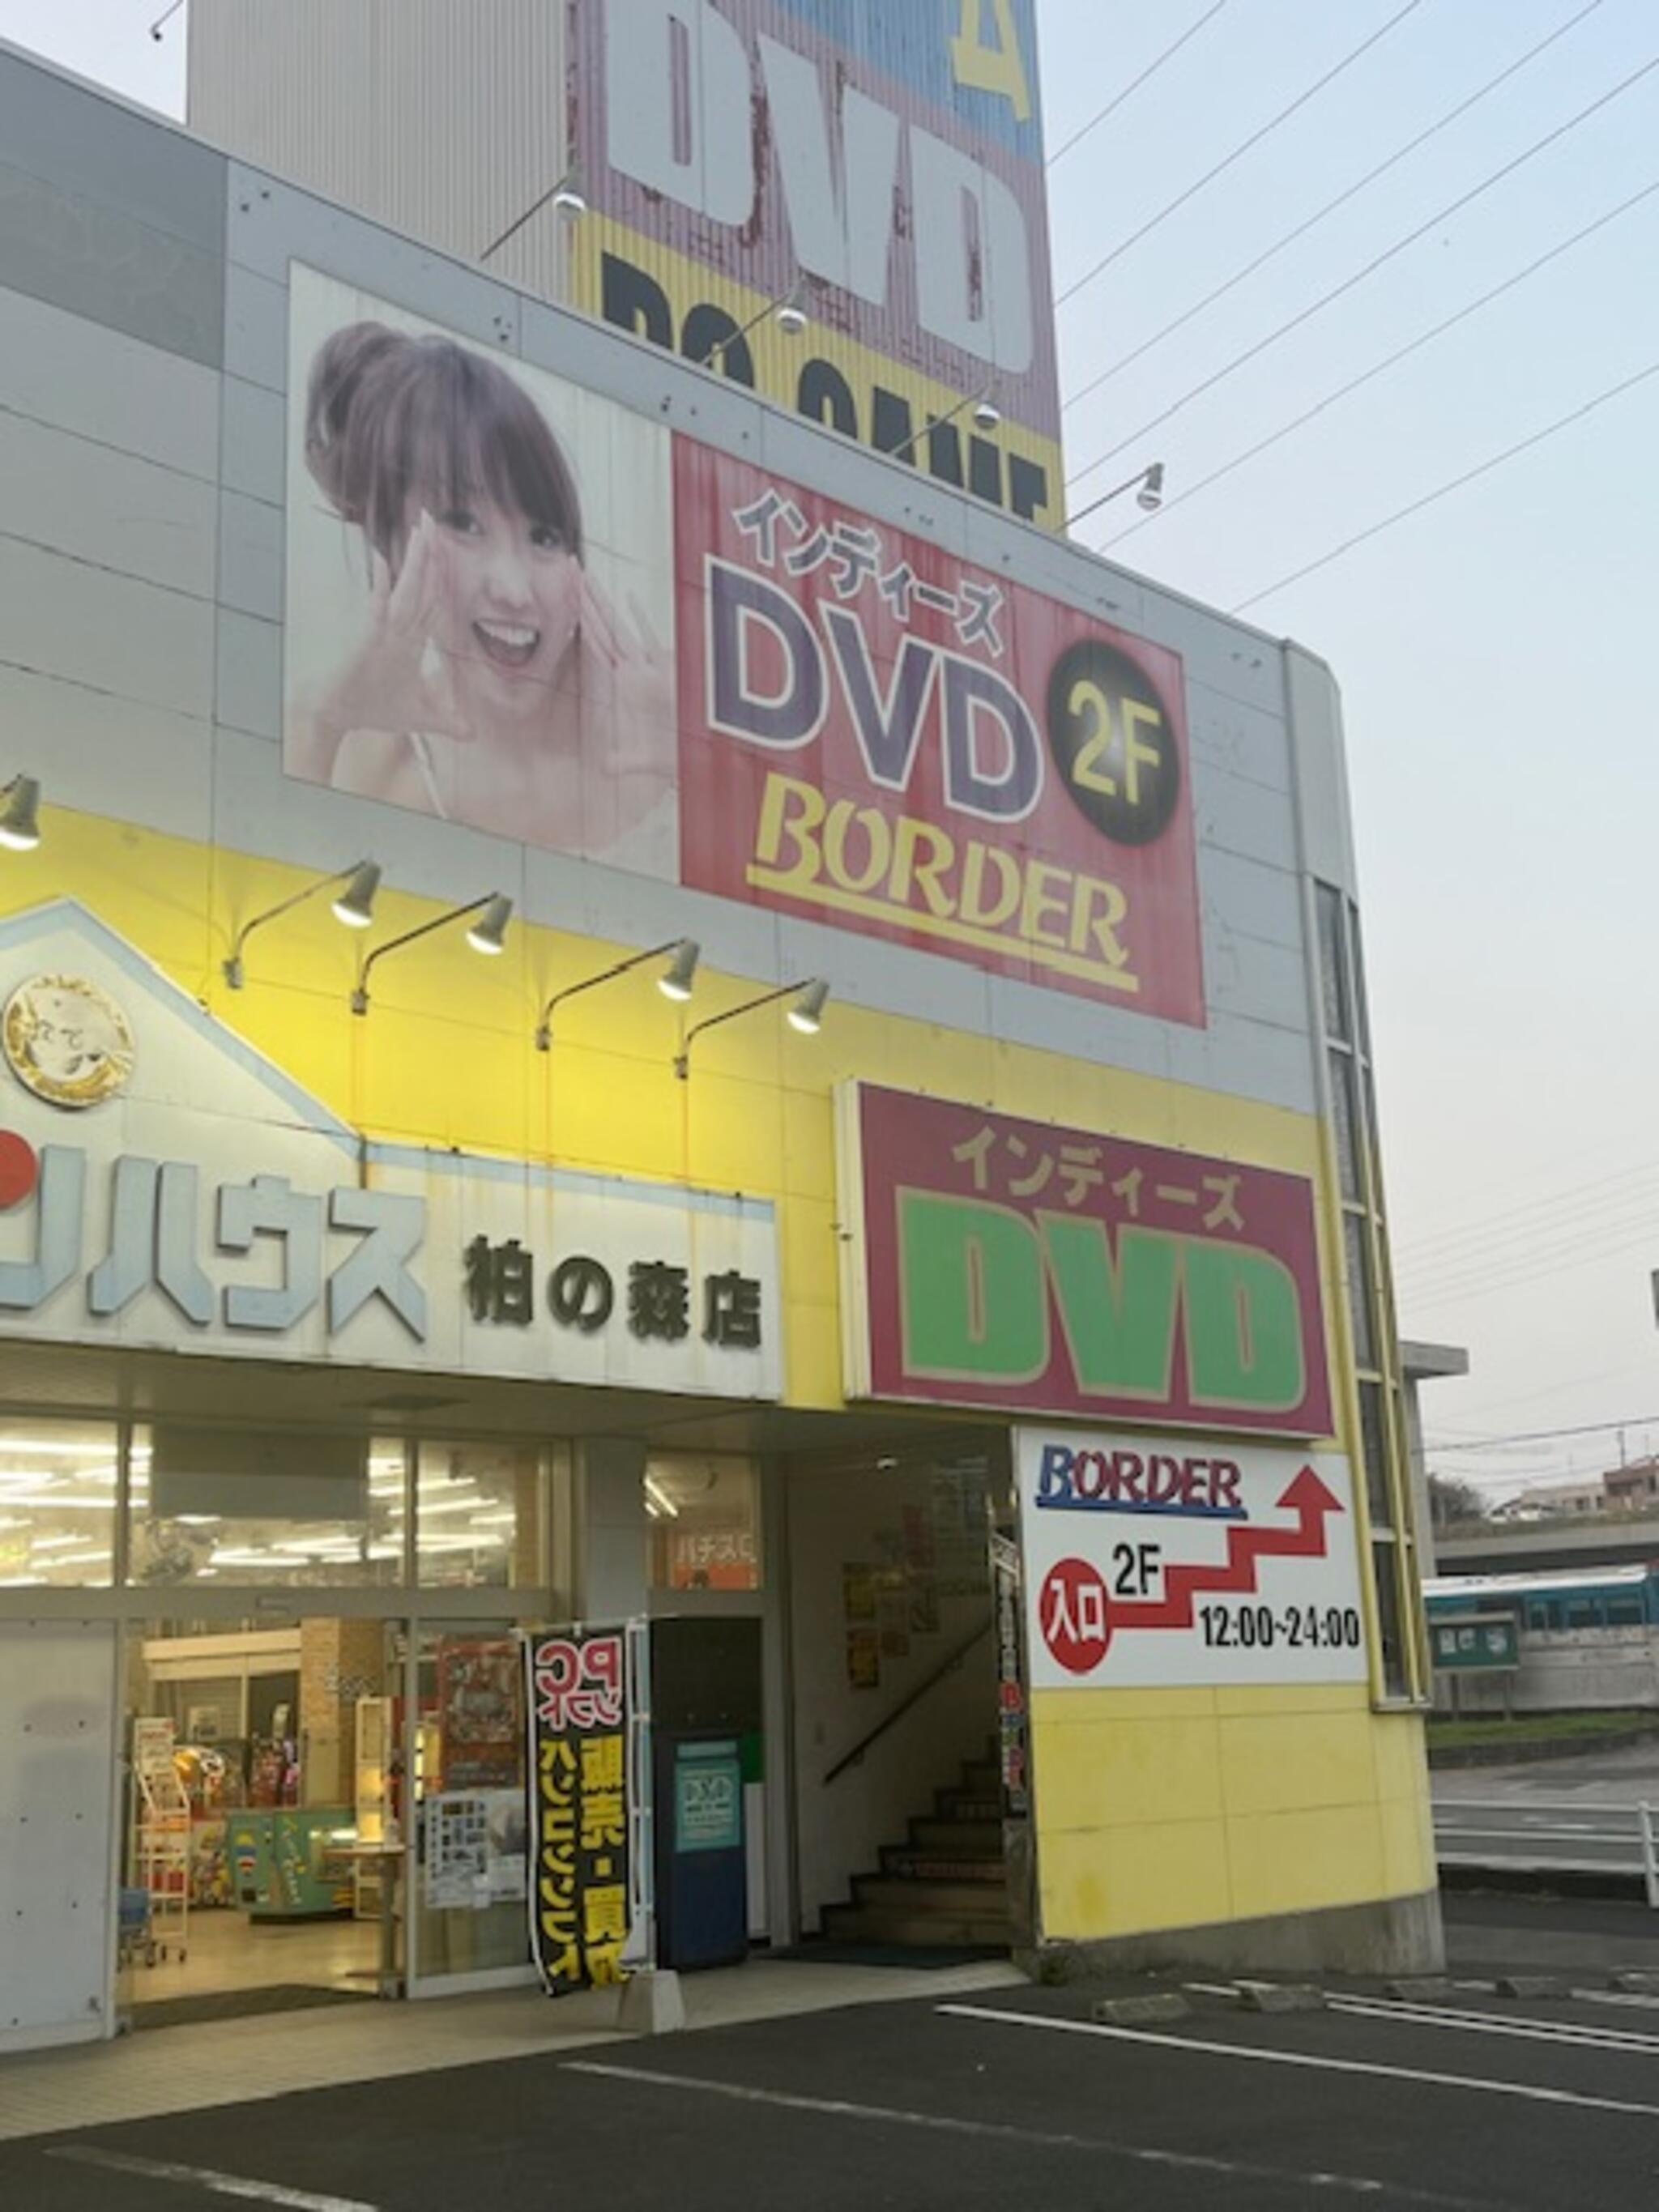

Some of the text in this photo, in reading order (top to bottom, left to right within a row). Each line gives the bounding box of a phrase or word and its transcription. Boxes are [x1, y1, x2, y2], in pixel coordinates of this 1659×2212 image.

[606, 0, 1034, 375] DVD
[732, 486, 1005, 656] インディーズ
[704, 553, 1044, 824] DVD
[1067, 679, 1161, 804] 2F
[753, 771, 1130, 969] BORDER
[951, 1126, 1245, 1231] インディーズ
[463, 1234, 762, 1349] 柏の森店
[895, 1184, 1307, 1413] DVD
[1038, 1444, 1243, 1509] BORDER
[1047, 1579, 1107, 1643] 入口
[1112, 1544, 1162, 1596] 2F
